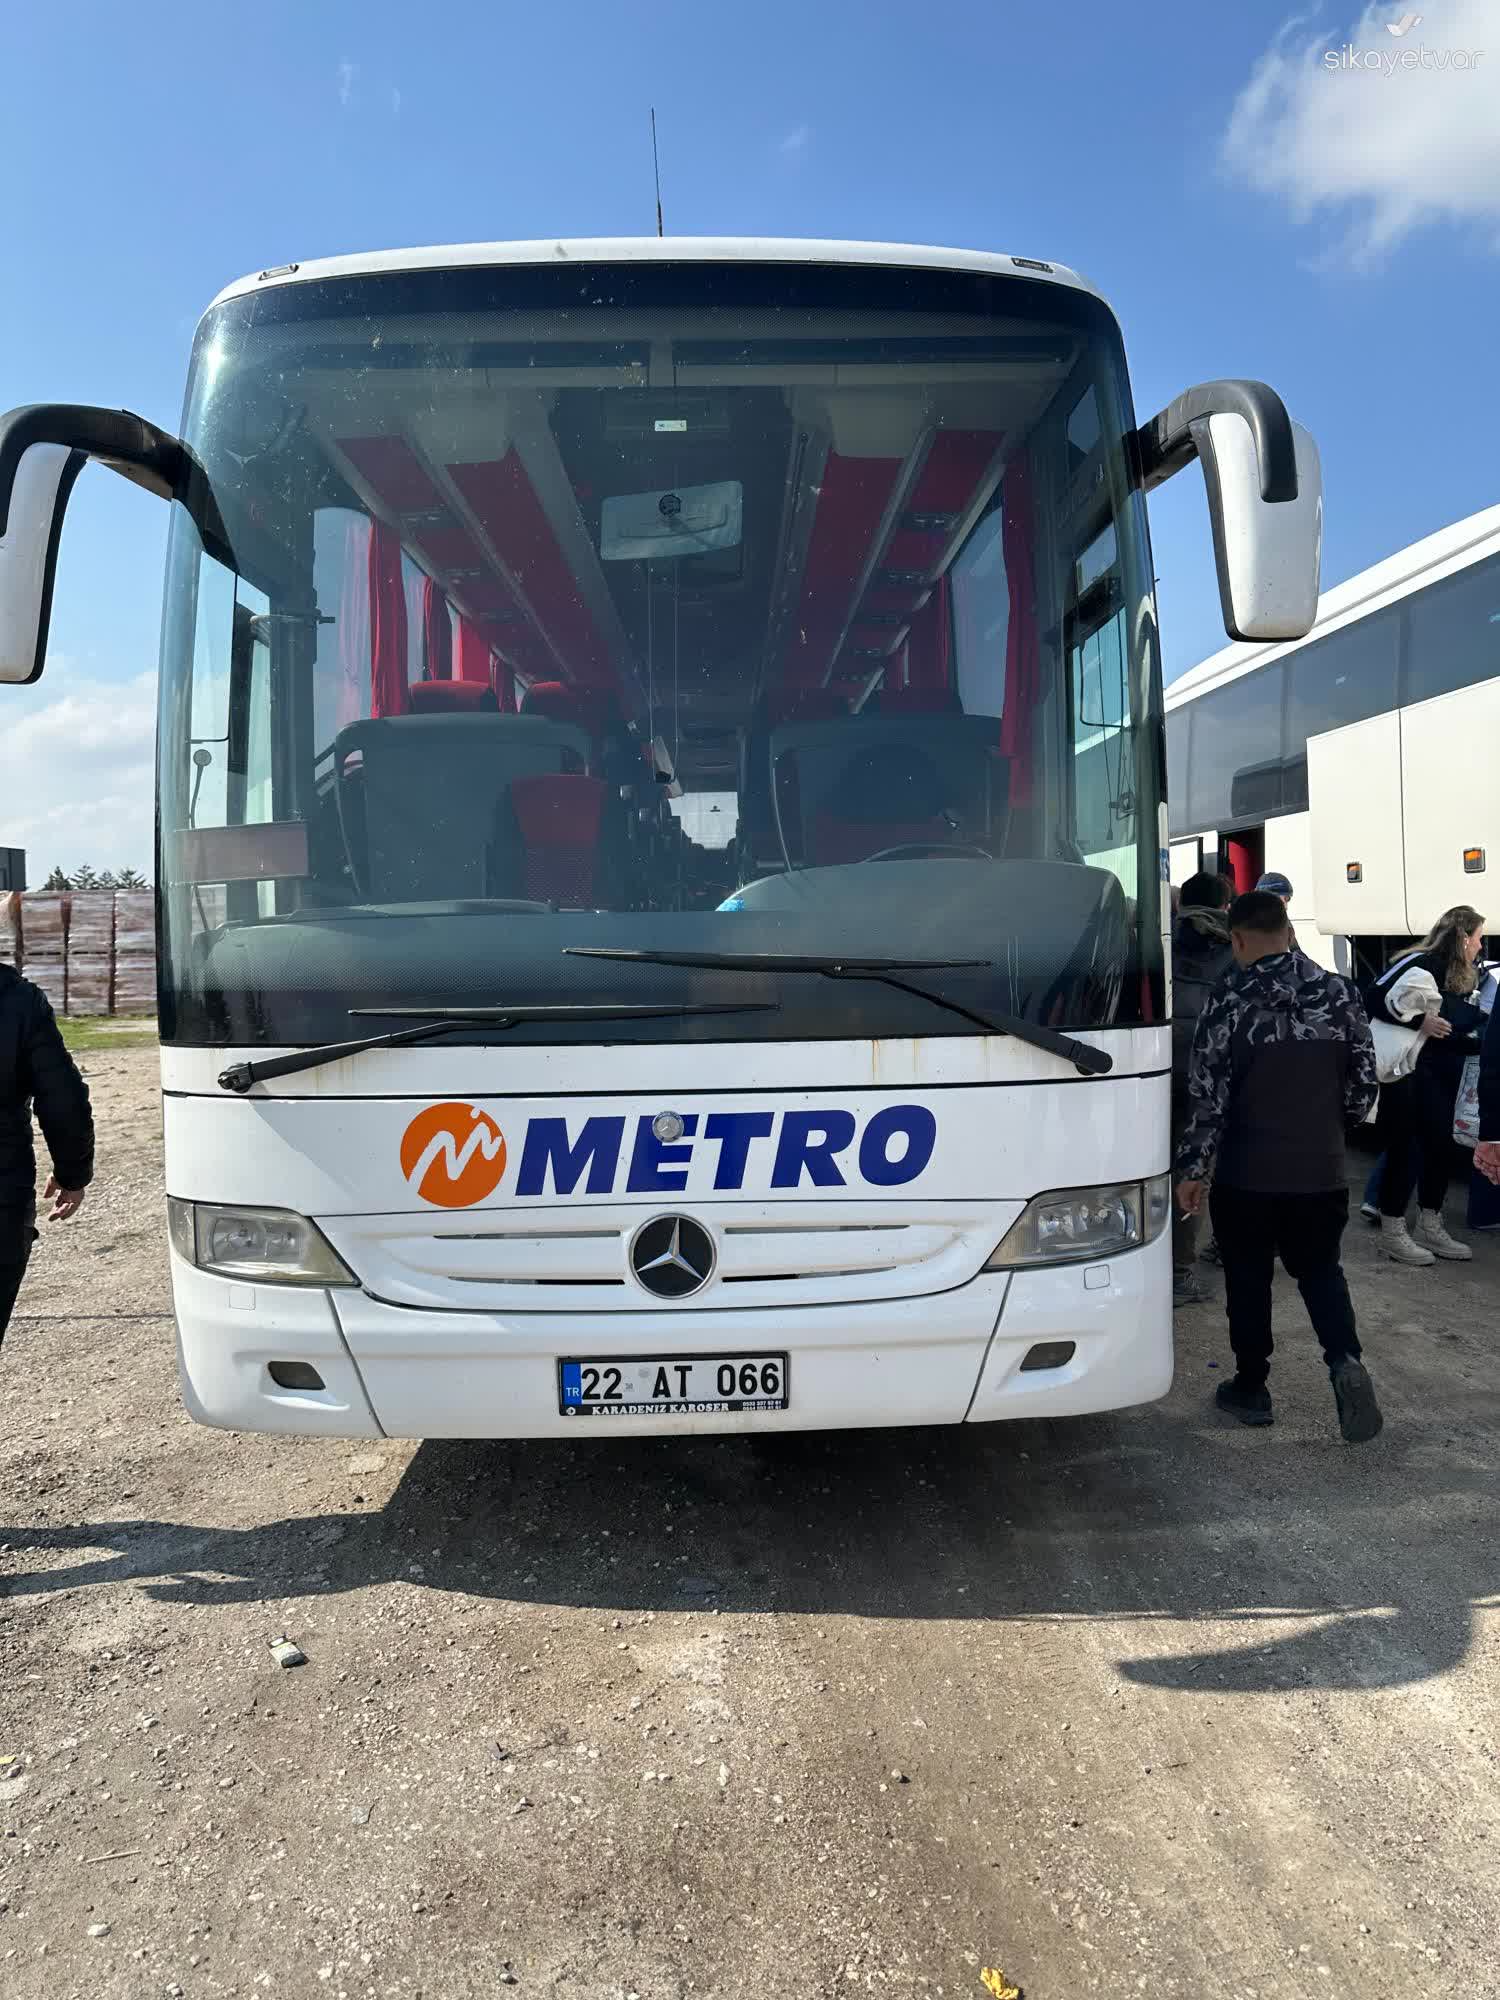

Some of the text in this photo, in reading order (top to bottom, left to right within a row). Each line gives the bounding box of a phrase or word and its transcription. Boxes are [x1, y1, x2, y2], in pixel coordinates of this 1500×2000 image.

[515, 1104, 936, 1196] METRO
[566, 1387, 580, 1397] TR
[581, 1362, 780, 1400] 22 AT 066
[669, 1402, 729, 1414] KAROSER
